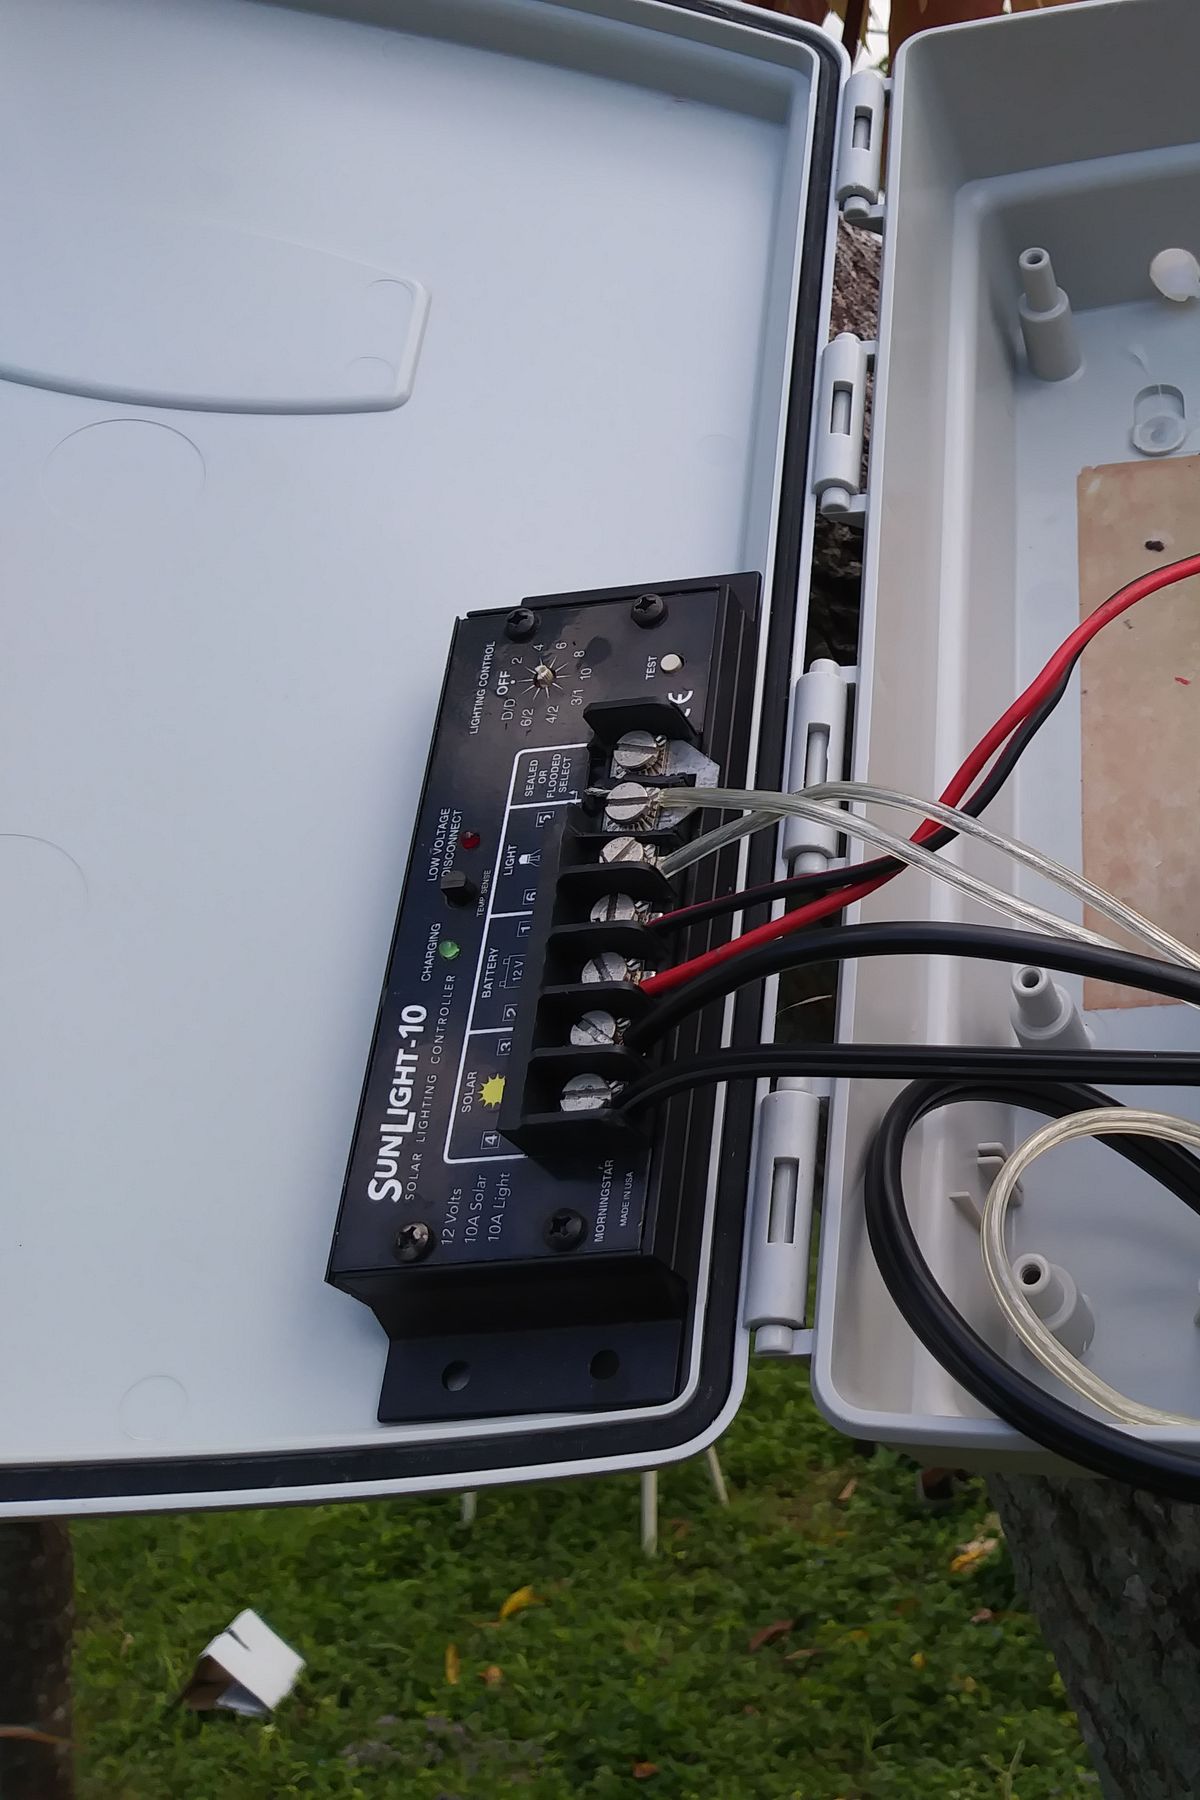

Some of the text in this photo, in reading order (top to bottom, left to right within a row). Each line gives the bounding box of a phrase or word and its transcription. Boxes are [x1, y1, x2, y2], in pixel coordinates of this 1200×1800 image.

[533, 643, 544, 651] 4
[556, 642, 567, 650] 6
[573, 650, 585, 658] 8
[496, 670, 513, 696] OFF
[580, 667, 592, 681] 10
[645, 656, 657, 680] TEST
[469, 641, 496, 735] LIGHTING CONTROL
[571, 688, 584, 706] 3/1
[501, 698, 516, 721] D/D
[520, 708, 534, 727] 6/2
[545, 705, 559, 724] 4/2
[524, 759, 539, 797] SEALED
[537, 770, 548, 784] OR
[546, 753, 562, 798] FLOODED
[558, 757, 572, 793] SELECT
[427, 807, 451, 882] LOW VOLTAGE
[441, 809, 463, 877] DISCONNECT
[503, 845, 517, 876] LIGHT
[481, 869, 491, 894] SENSE
[421, 923, 441, 982] CHARGING
[481, 948, 499, 998] BATTERY
[405, 974, 456, 1200] SOLAR LIGHTING CONTROLLER
[461, 1070, 477, 1113] SOLAR
[441, 1188, 462, 1246] 12 Volts
[465, 1175, 487, 1244] 10A Solar
[488, 1172, 511, 1242] 10A Light
[594, 1159, 614, 1242] MORNINGSTAR
[620, 1171, 634, 1227] MADE IN USA
